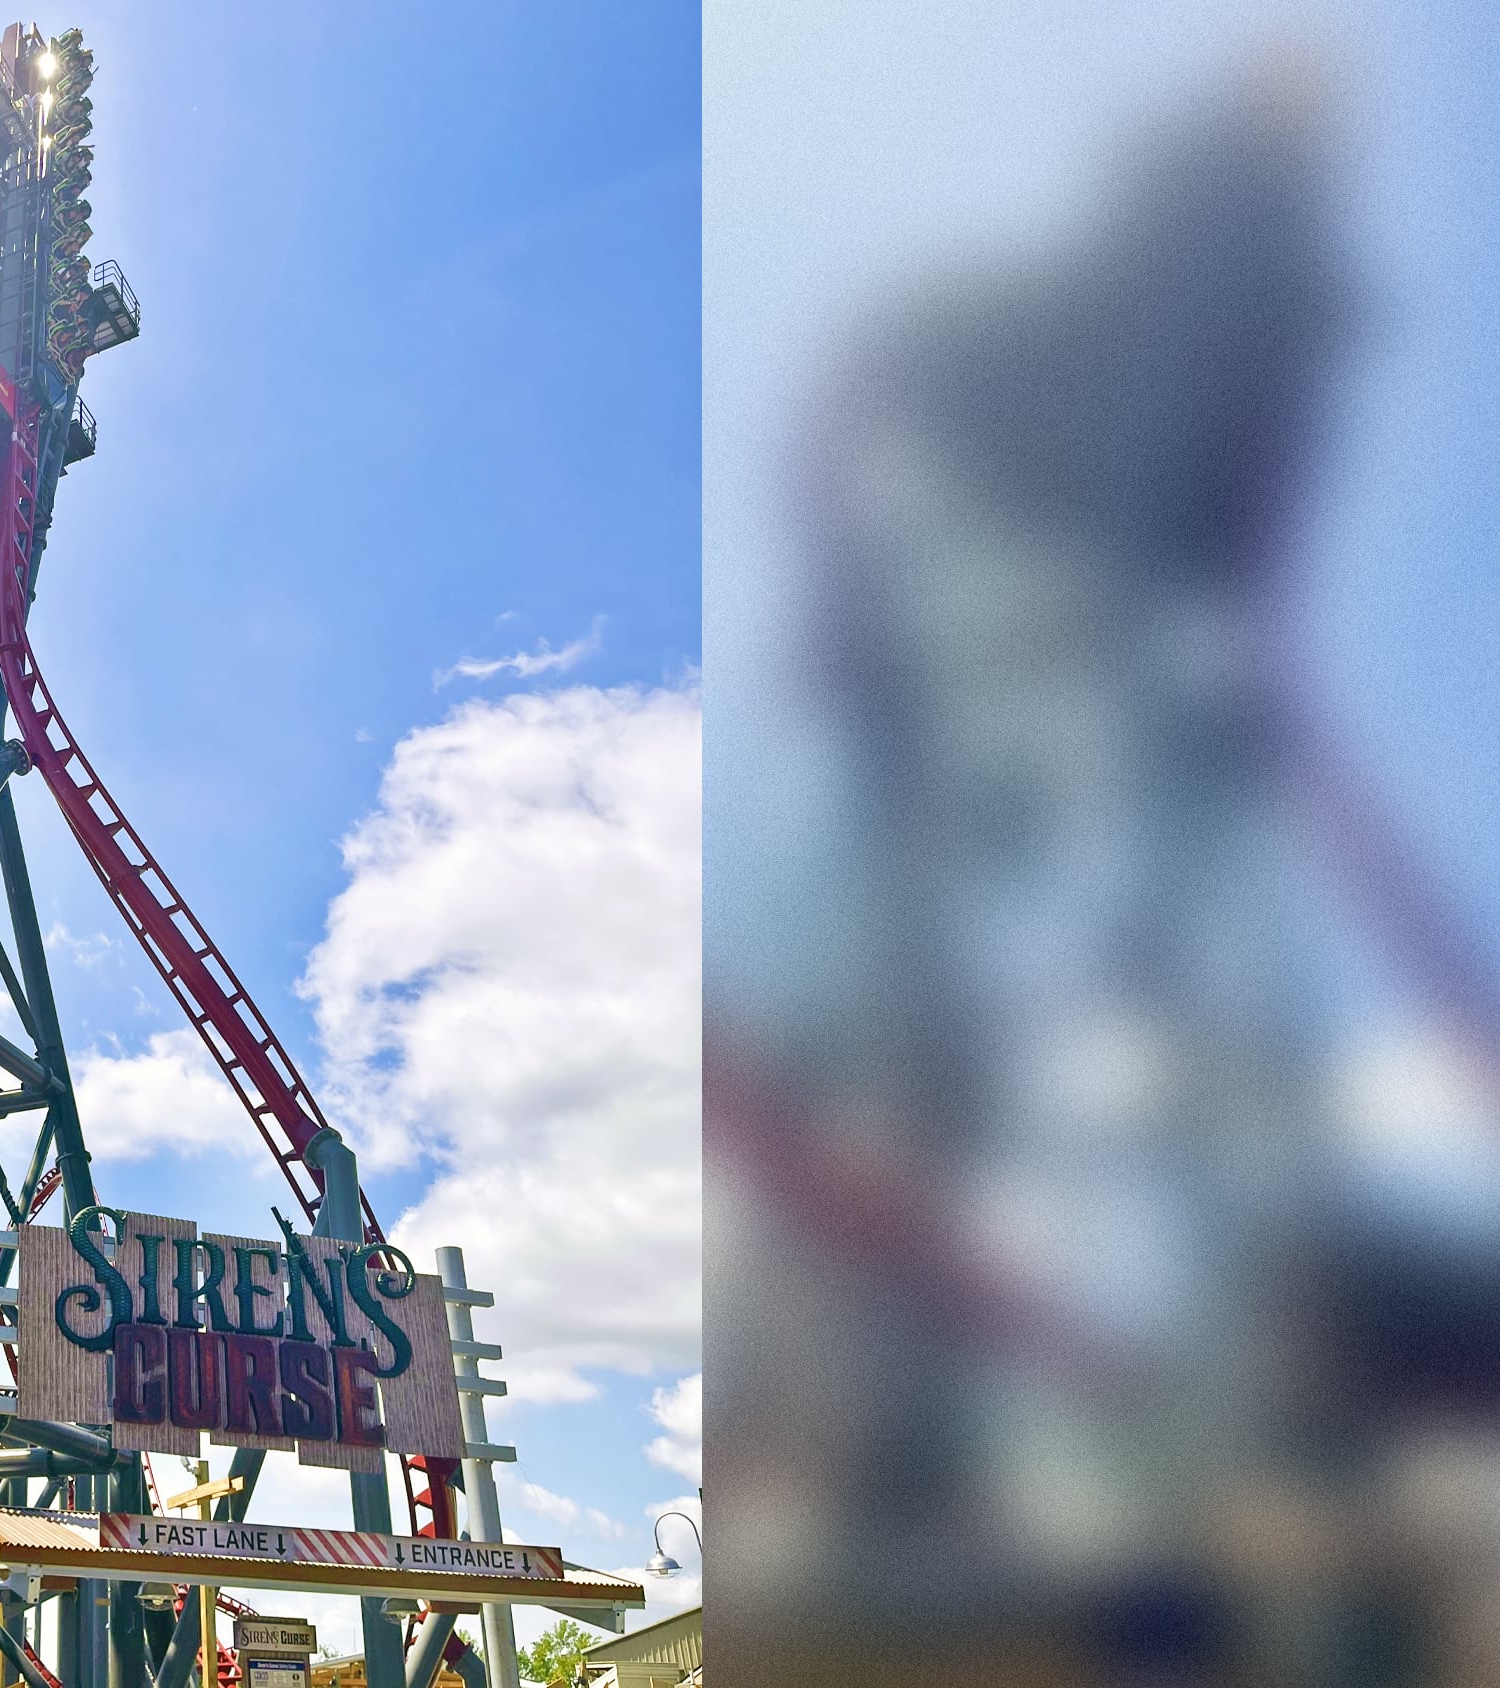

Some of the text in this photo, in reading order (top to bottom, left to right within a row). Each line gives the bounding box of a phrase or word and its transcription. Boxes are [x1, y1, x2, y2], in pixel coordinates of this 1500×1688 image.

[114, 1323, 384, 1447] CURSE
[155, 1524, 269, 1551] FAST LANE
[411, 1544, 516, 1570] ENTRANCE
[280, 1630, 311, 1646] CURSE
